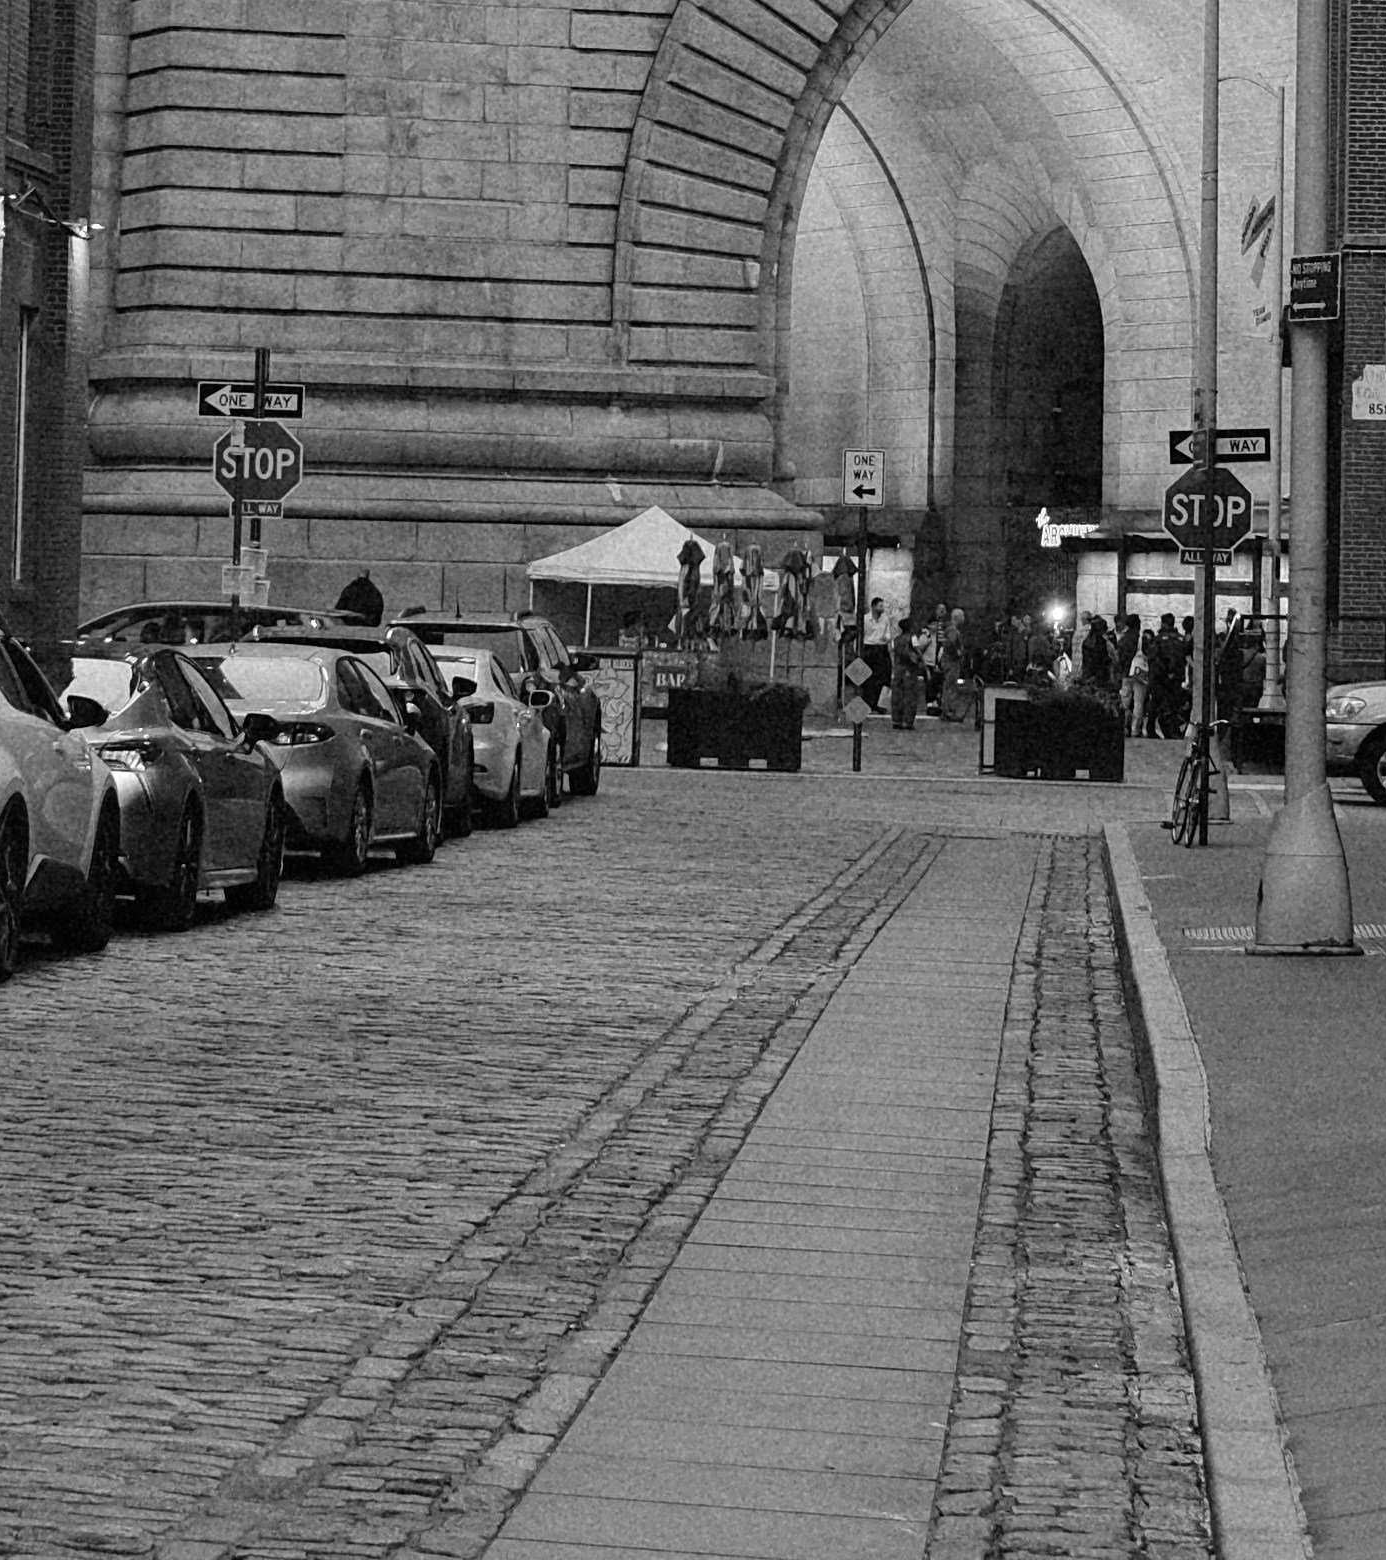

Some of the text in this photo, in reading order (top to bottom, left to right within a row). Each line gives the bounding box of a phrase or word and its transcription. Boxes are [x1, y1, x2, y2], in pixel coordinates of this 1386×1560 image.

[1302, 261, 1331, 274] STOPPING
[1292, 277, 1317, 291] Anytime
[219, 394, 292, 409] ONE WAY
[1230, 439, 1259, 453] WAY
[221, 446, 296, 480] STOP
[853, 454, 876, 467] ONE
[853, 468, 876, 482] WAY
[258, 503, 279, 515] WAY
[1184, 550, 1203, 563] ALL
